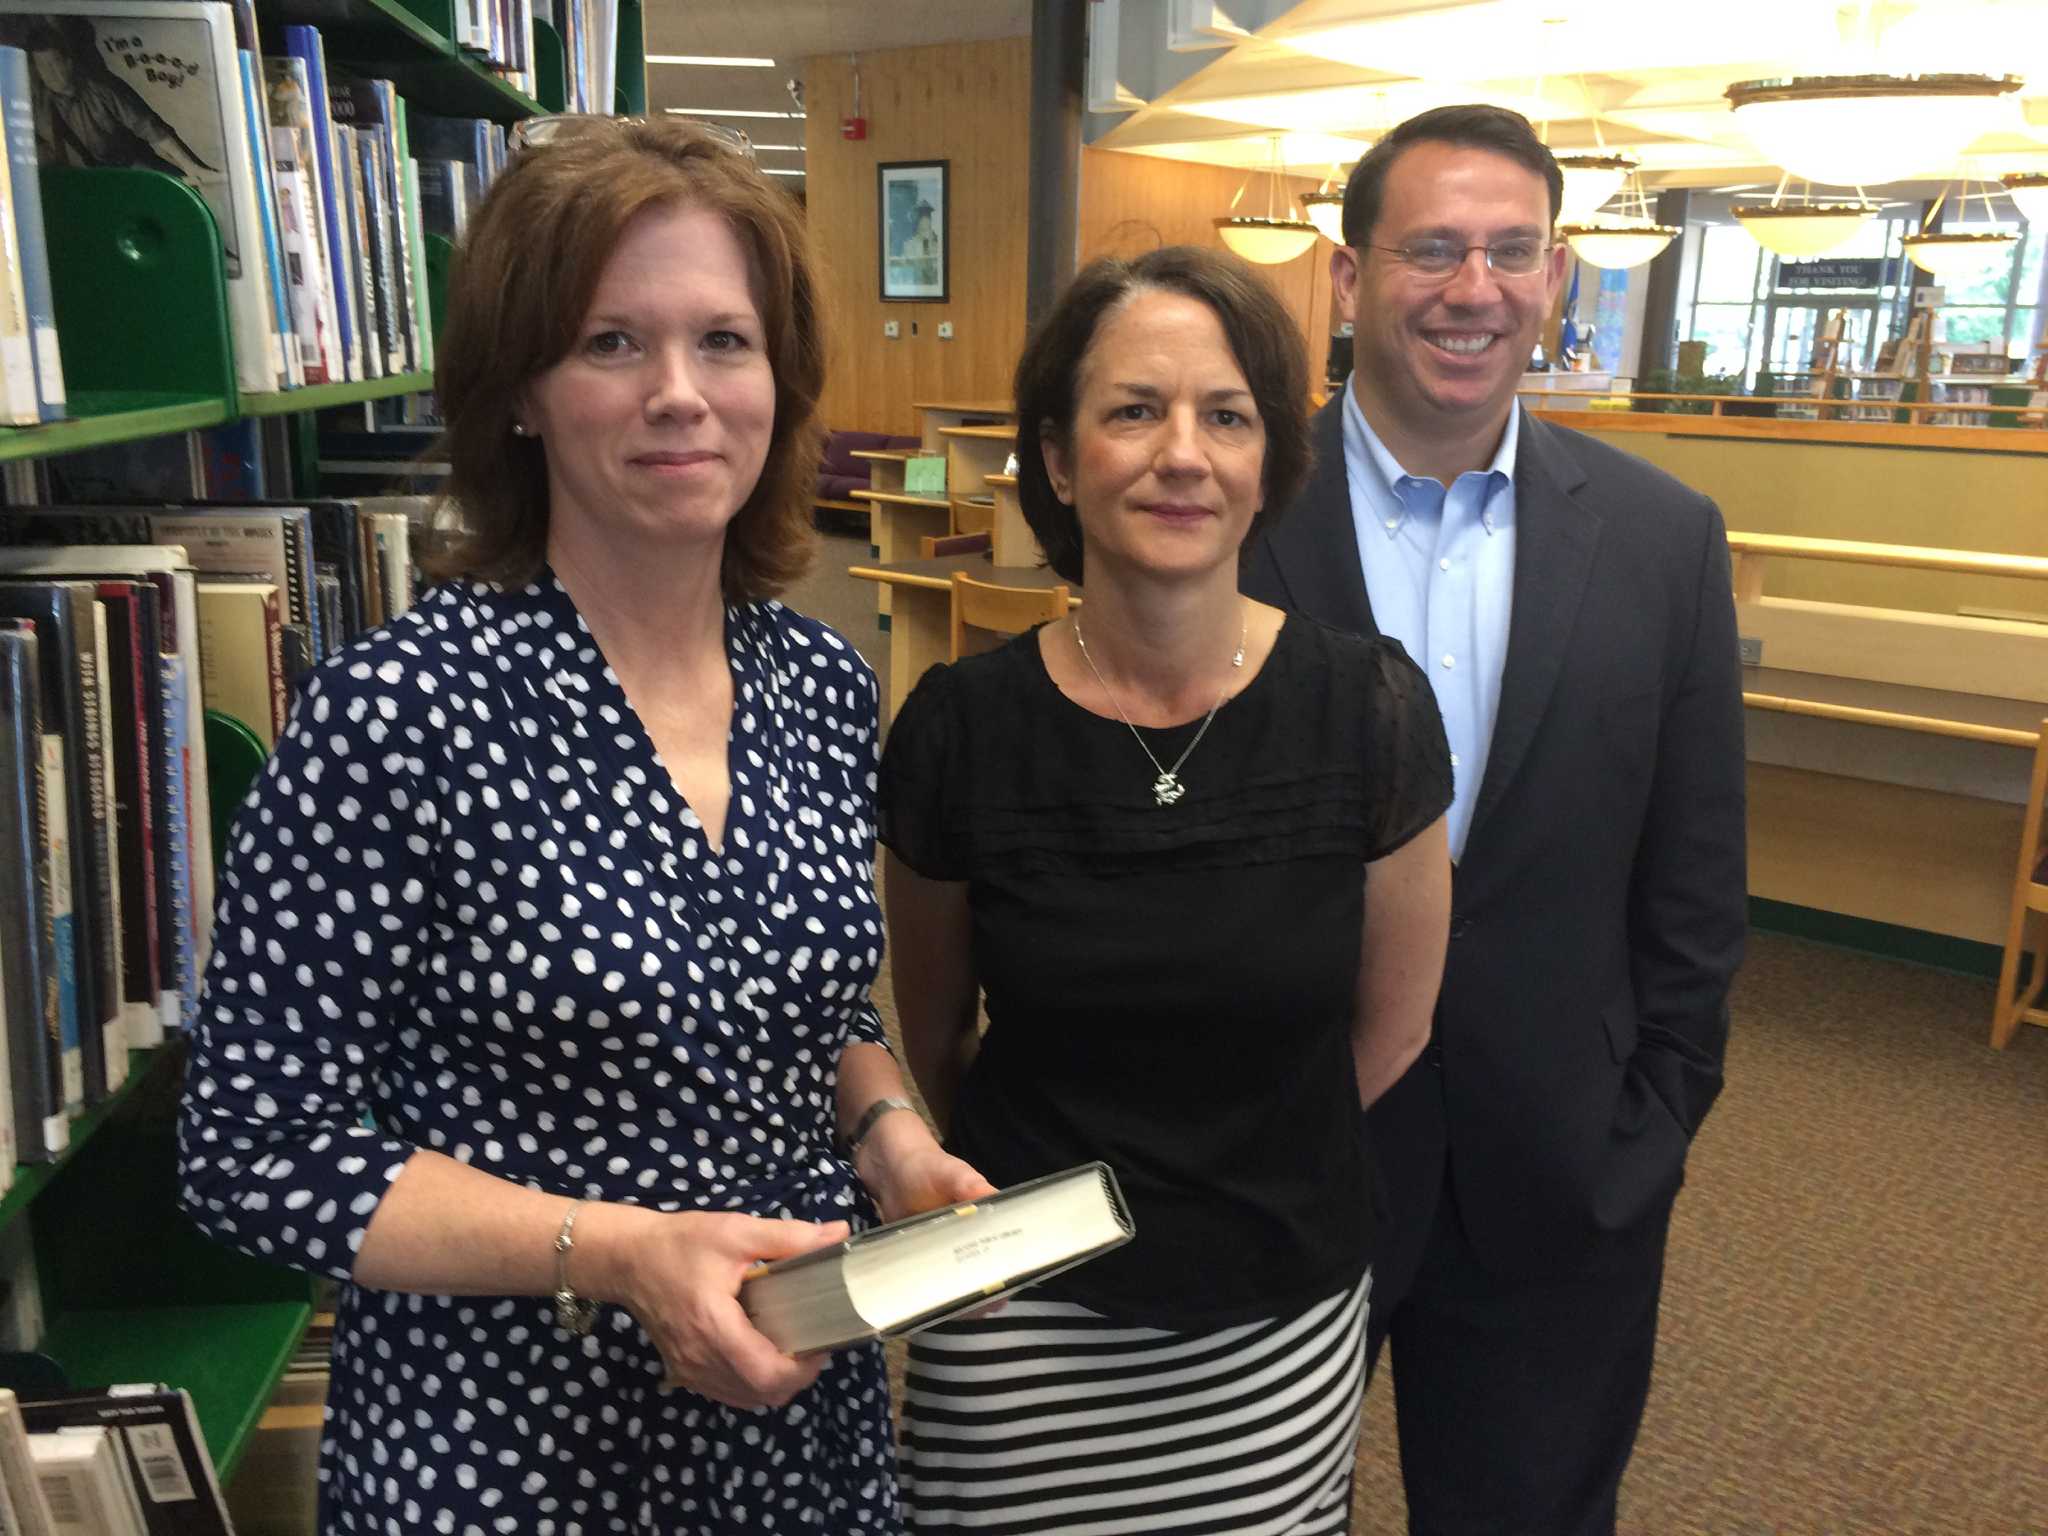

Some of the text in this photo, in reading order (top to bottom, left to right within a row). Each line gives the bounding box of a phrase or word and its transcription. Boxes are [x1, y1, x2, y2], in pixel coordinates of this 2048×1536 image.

[1795, 264, 1861, 274] THANK YOU
[1788, 277, 1809, 287] FOR
[79, 651, 96, 687] WITH
